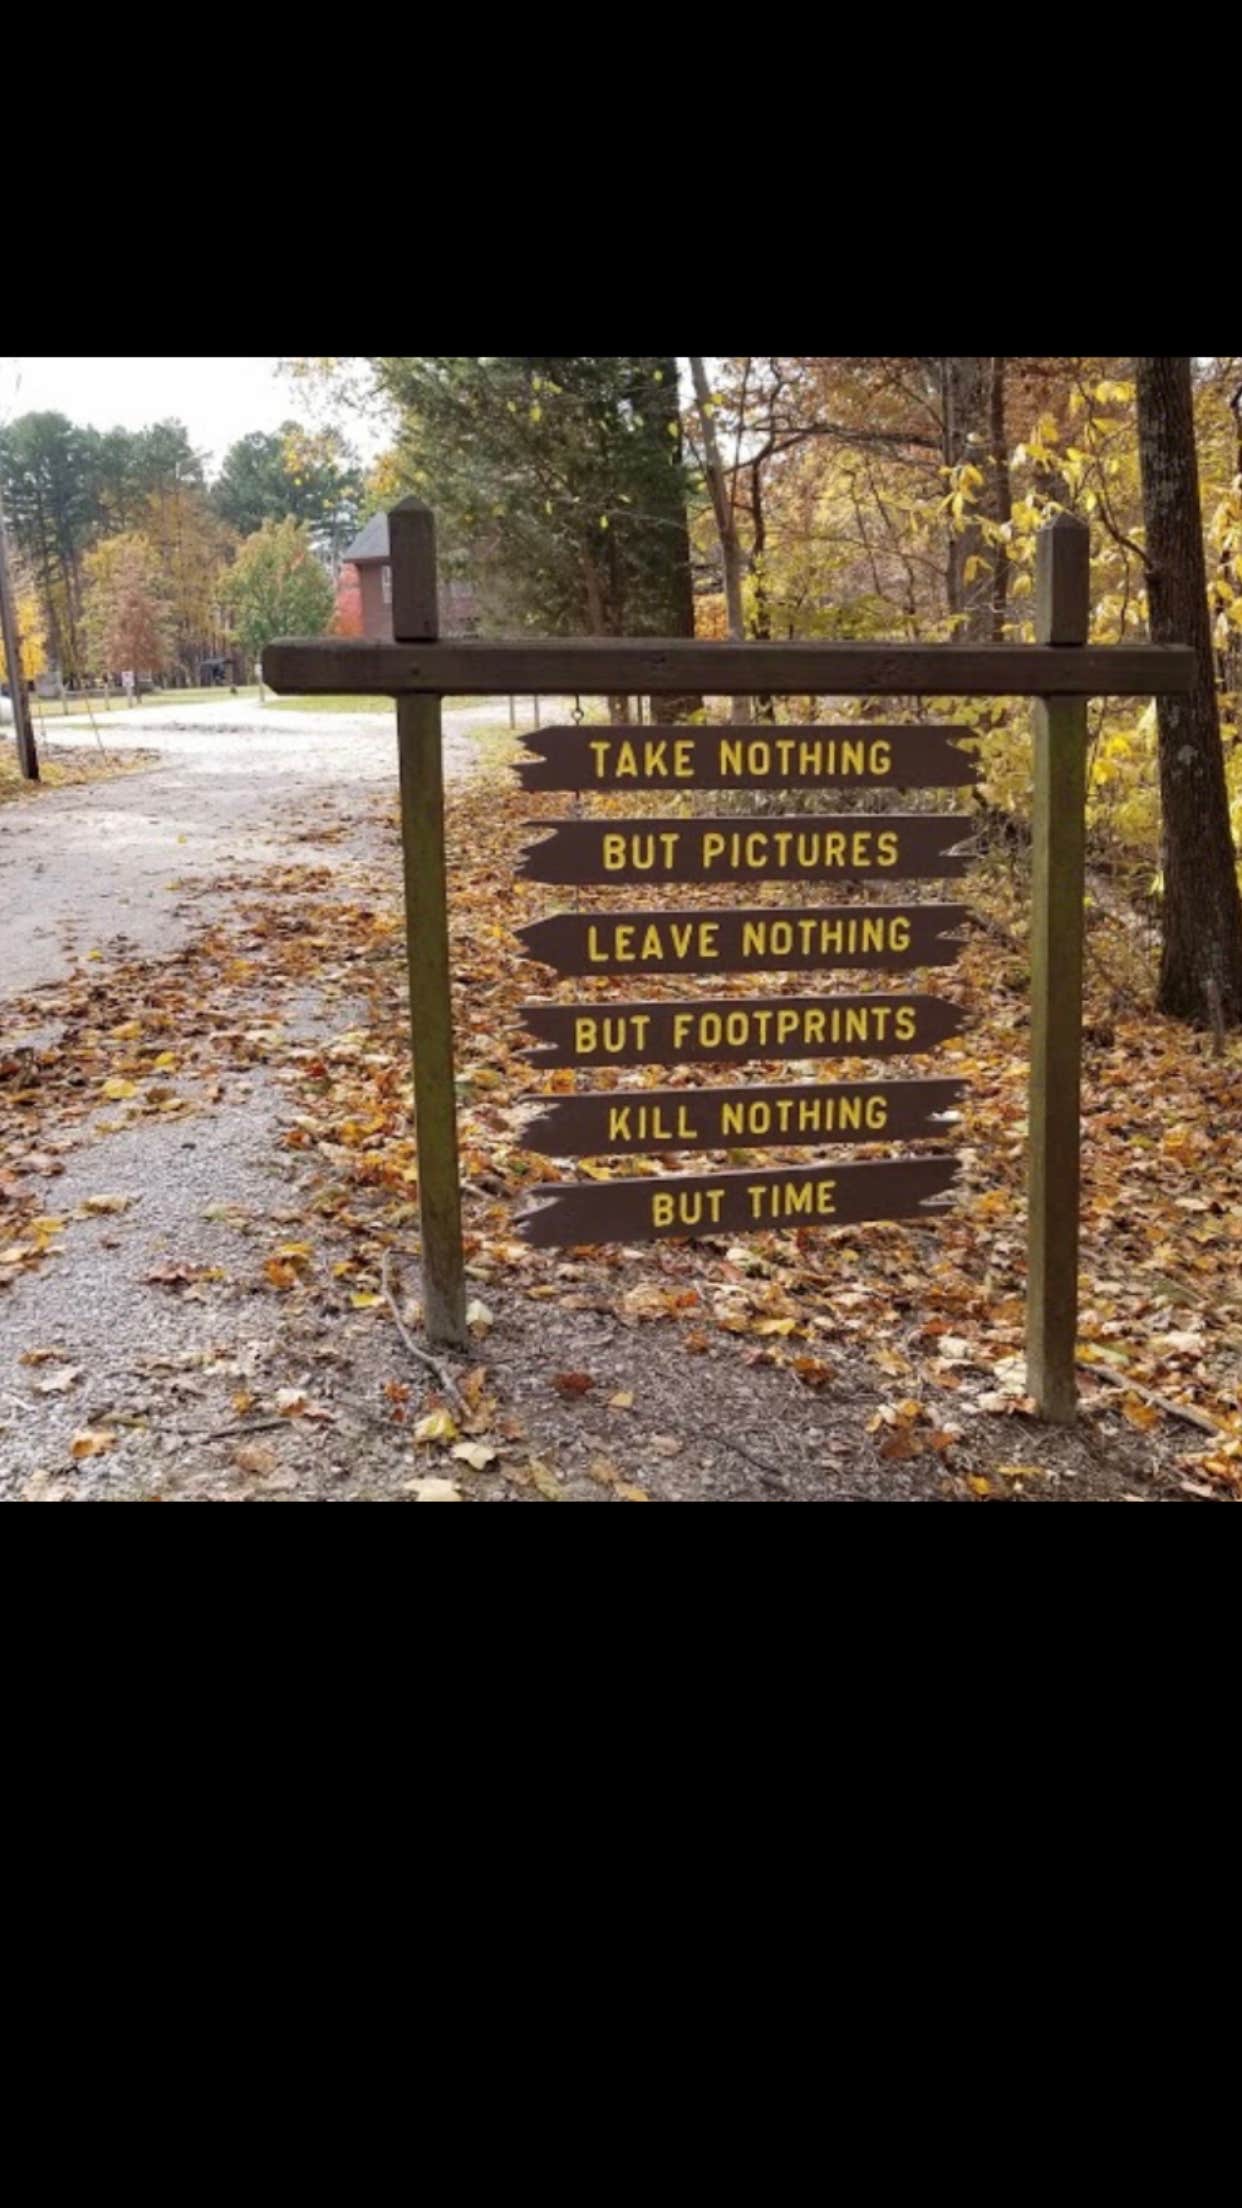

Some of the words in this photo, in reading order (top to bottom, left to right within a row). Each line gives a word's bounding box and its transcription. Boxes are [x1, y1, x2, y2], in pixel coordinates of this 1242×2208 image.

[590, 740, 694, 778] TAKE
[719, 739, 892, 776] NOTHING
[602, 833, 679, 870] BUT
[702, 831, 899, 868] PICTURES
[587, 922, 718, 962] LEAVE
[741, 916, 911, 956] NOTHING
[575, 1014, 649, 1054] BUT
[673, 1006, 916, 1048] FOOTPRINTS
[608, 1105, 697, 1141] KILL
[720, 1095, 888, 1135] NOTHING
[652, 1189, 726, 1227] BUT
[748, 1181, 835, 1218] TIME
